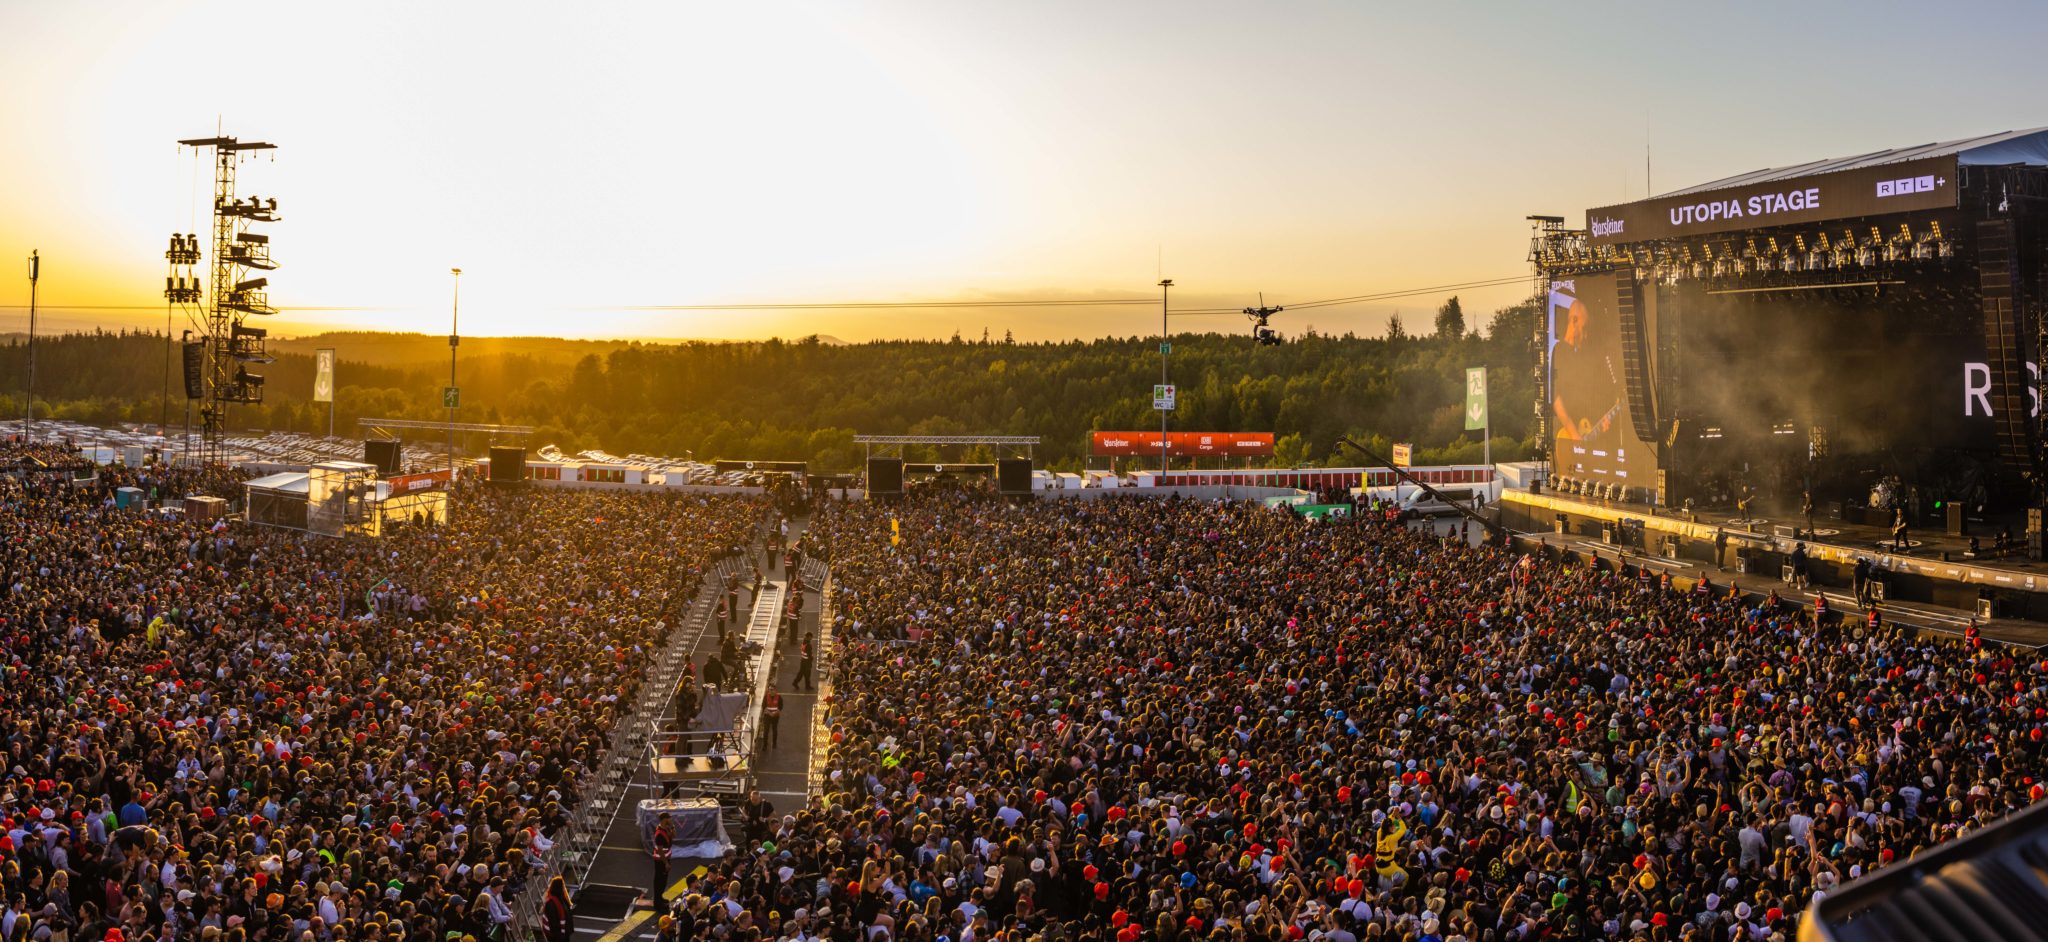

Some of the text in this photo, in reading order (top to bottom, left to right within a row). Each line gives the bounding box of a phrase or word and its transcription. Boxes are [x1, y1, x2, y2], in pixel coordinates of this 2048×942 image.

[1877, 176, 1946, 196] RTL+
[1670, 188, 1820, 226] UTOPIA STAGE
[1591, 216, 1624, 238] Warsteiner
